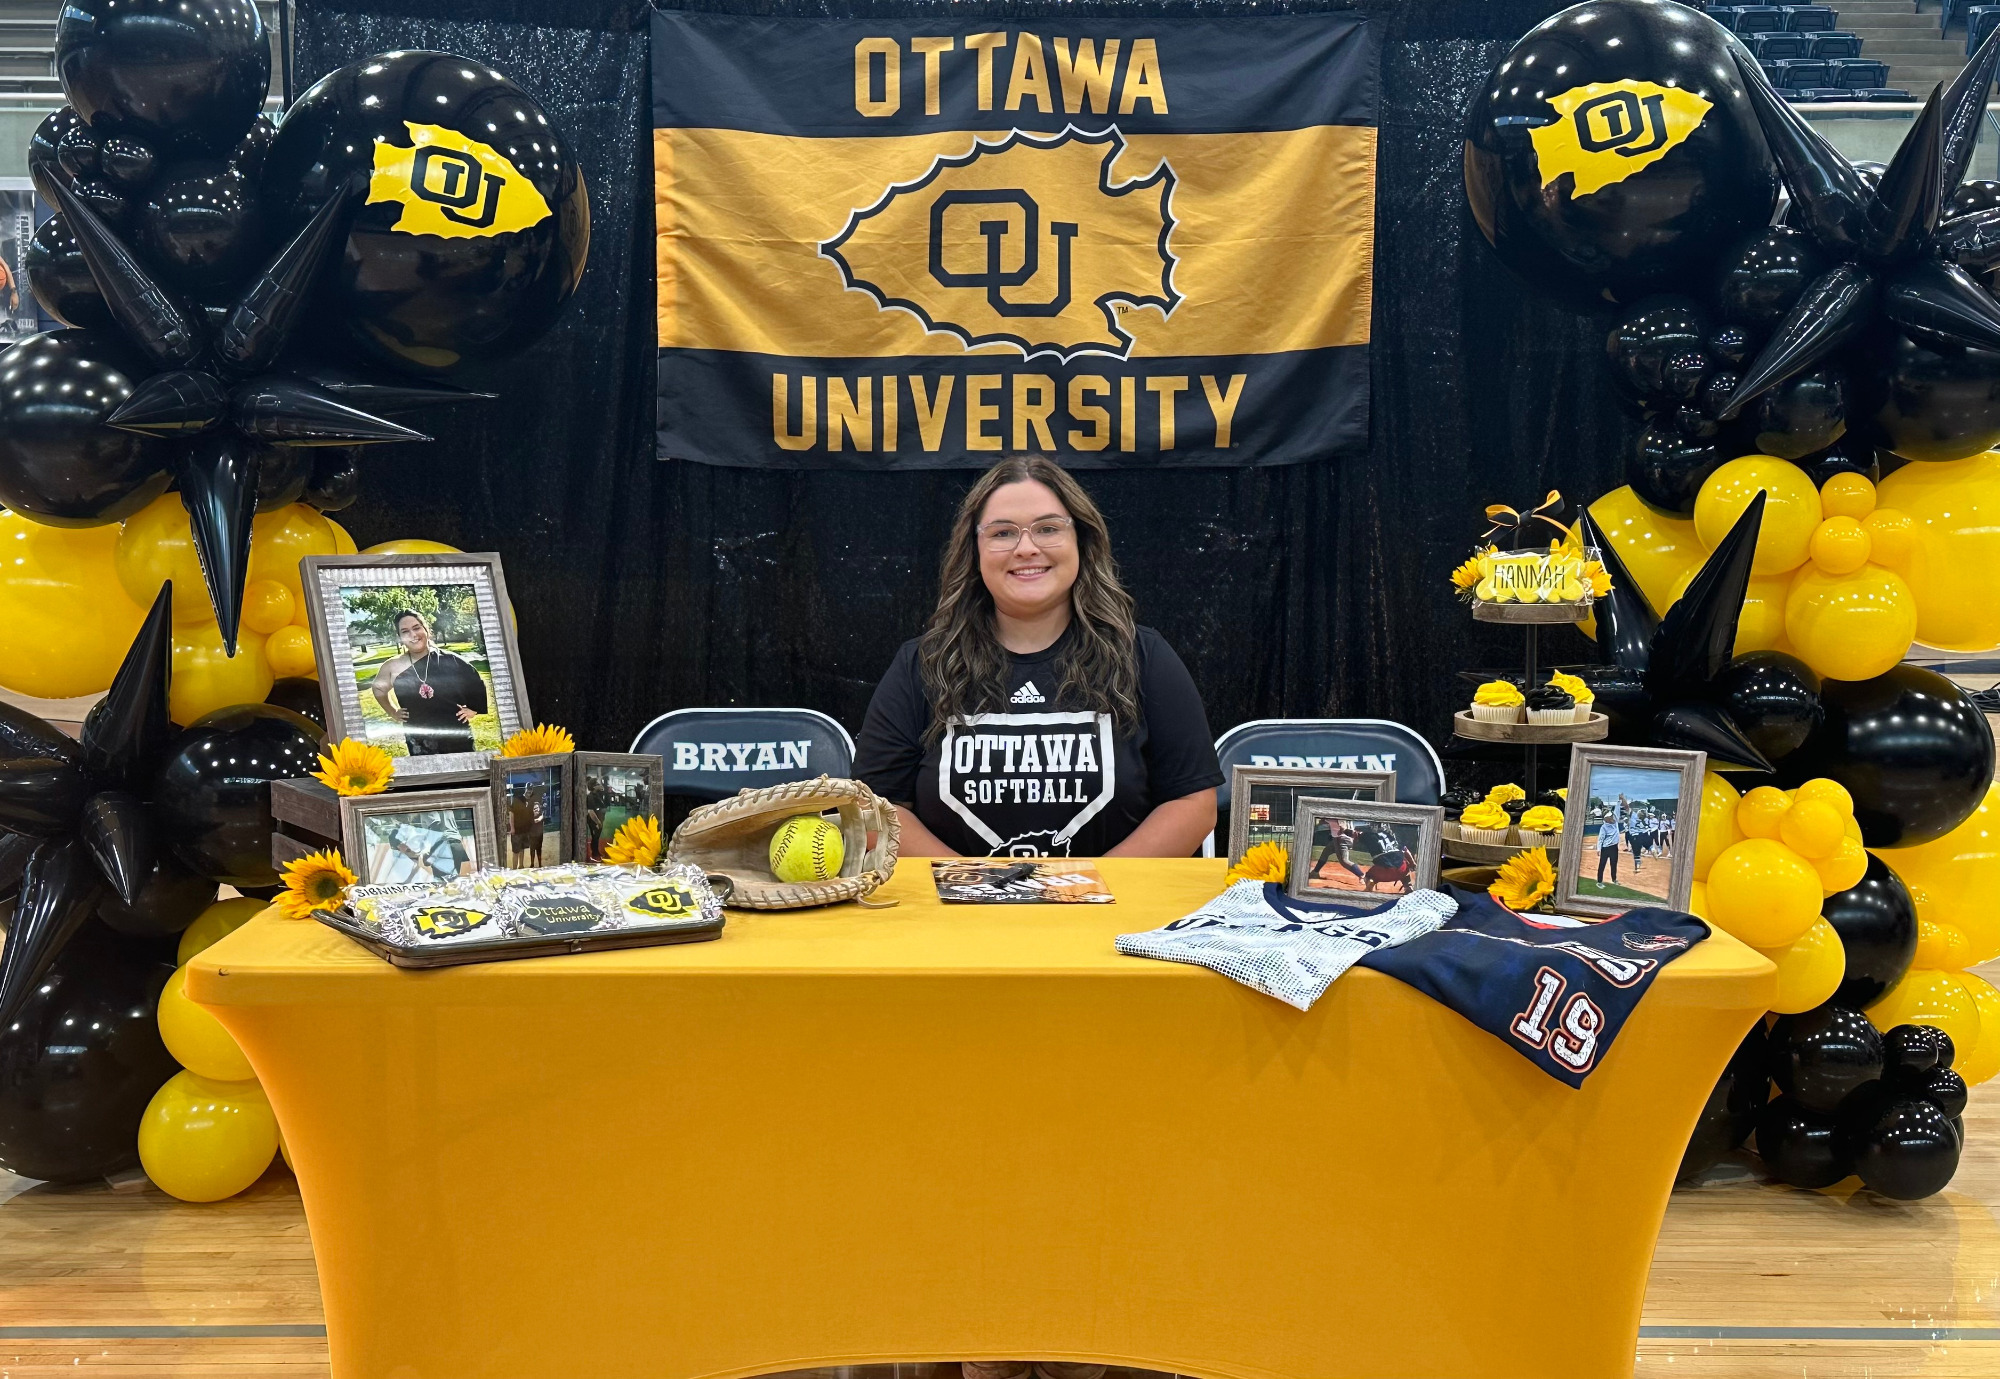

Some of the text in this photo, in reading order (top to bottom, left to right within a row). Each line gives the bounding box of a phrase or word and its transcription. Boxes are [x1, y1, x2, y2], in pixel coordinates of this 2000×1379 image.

[854, 30, 1169, 118] OTTAWA
[1572, 89, 1669, 158] OU
[410, 144, 507, 229] OU
[928, 188, 1079, 317] OU
[772, 372, 1248, 452] UNIVERSITY
[1493, 564, 1565, 590] HANNAH
[1010, 694, 1046, 704] adidas
[673, 739, 812, 772] BRYAN
[954, 733, 1099, 774] OTTAWA
[963, 778, 1088, 805] SOFTBALL
[524, 904, 591, 920] Ottawa
[546, 913, 601, 925] University
[645, 890, 682, 911] OU
[1510, 965, 1605, 1074] 19
